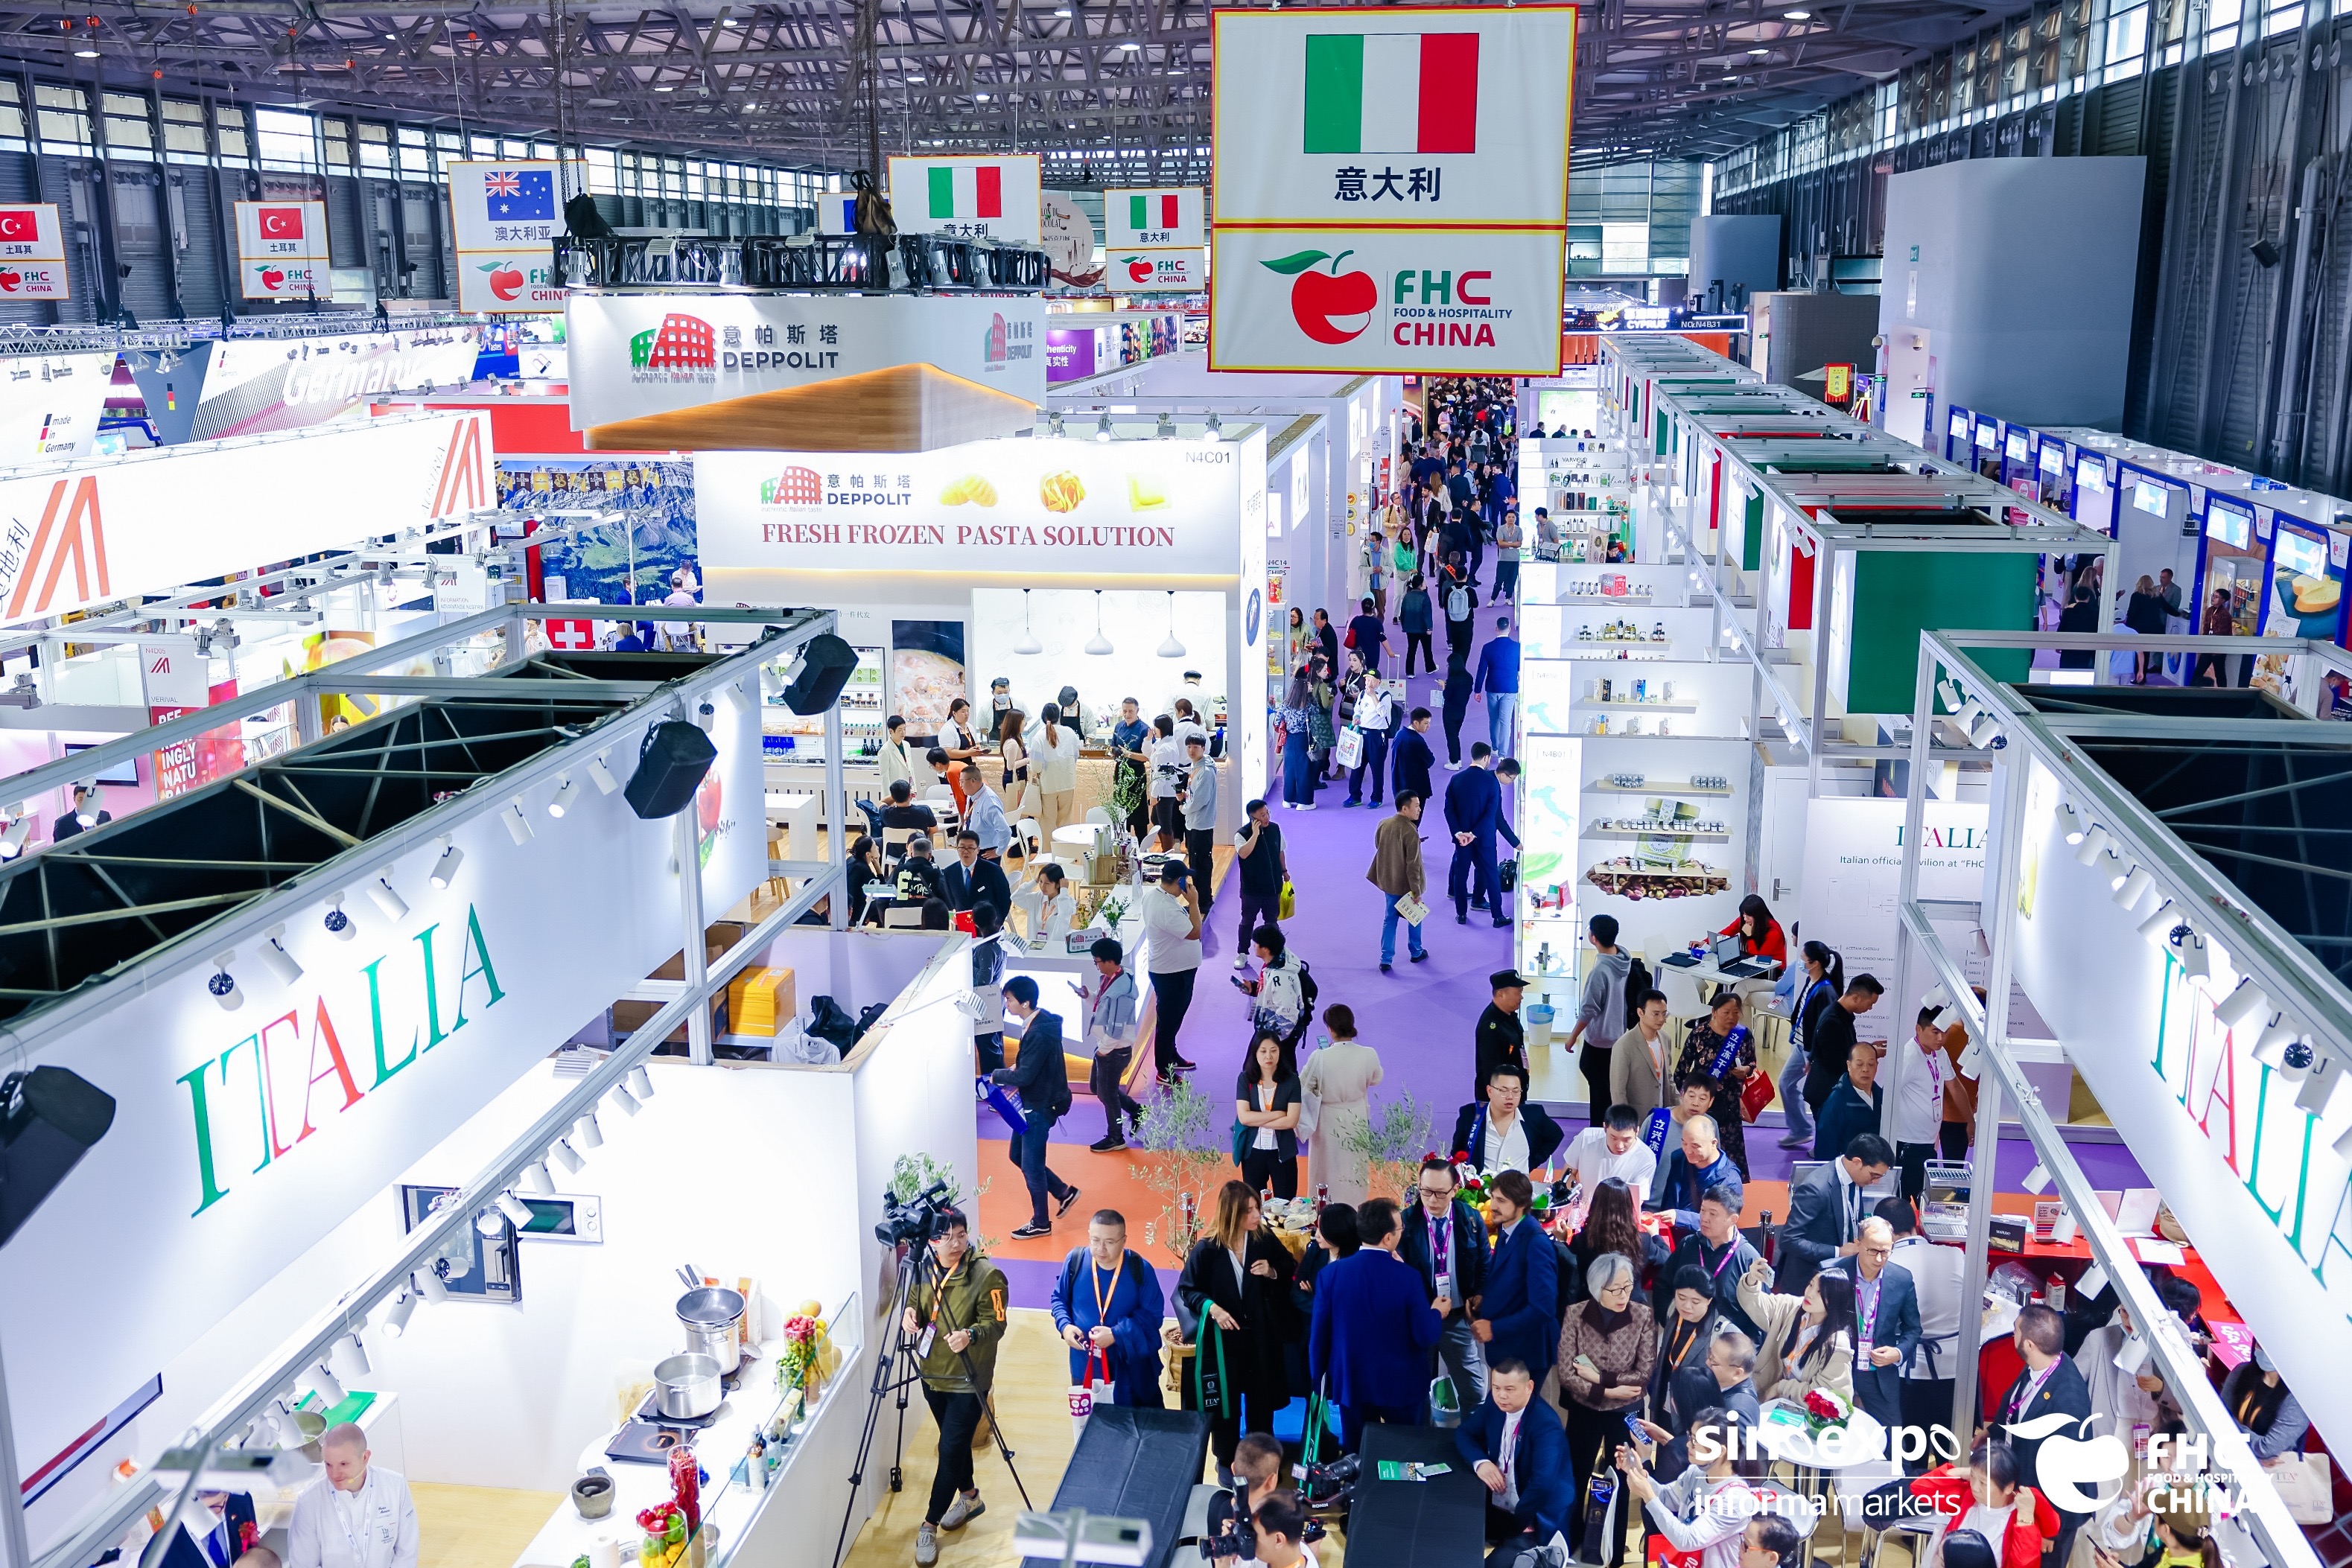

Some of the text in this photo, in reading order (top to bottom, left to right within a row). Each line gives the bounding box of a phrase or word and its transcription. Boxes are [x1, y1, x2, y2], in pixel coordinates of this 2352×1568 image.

[1335, 166, 1442, 203] 意大利
[495, 226, 552, 241] 澳大利亚
[1140, 232, 1170, 243] 意大利
[6, 245, 33, 255] 土耳其
[270, 243, 297, 252] 土耳其
[1157, 261, 1185, 271] FHC
[25, 271, 50, 281] FHC
[287, 270, 313, 280] FHC
[1394, 270, 1493, 306] FHC
[1393, 307, 1513, 319] FOOD & HOSPITALITY
[1626, 320, 1668, 329] CYPRUS
[722, 324, 839, 345] 意帕斯塔
[1393, 322, 1496, 348] CHINA
[1006, 344, 1033, 361] DEPPOLIT
[722, 351, 839, 369] DEPPOLIT
[52, 414, 71, 426] made
[48, 430, 56, 439] in
[45, 441, 76, 453] Germany
[1185, 451, 1230, 464] N4C01
[827, 474, 911, 489] 意帕斯塔
[827, 493, 912, 506] DEPPOLIT
[761, 523, 1176, 547] FRESH FROZEN PASTA SOLUTION
[161, 742, 197, 771] INGLY
[162, 760, 197, 789] NATU
[1840, 855, 1869, 864] Italian
[1872, 856, 1902, 865] officia
[1272, 976, 1281, 987] R
[176, 902, 506, 1220] ITALIA
